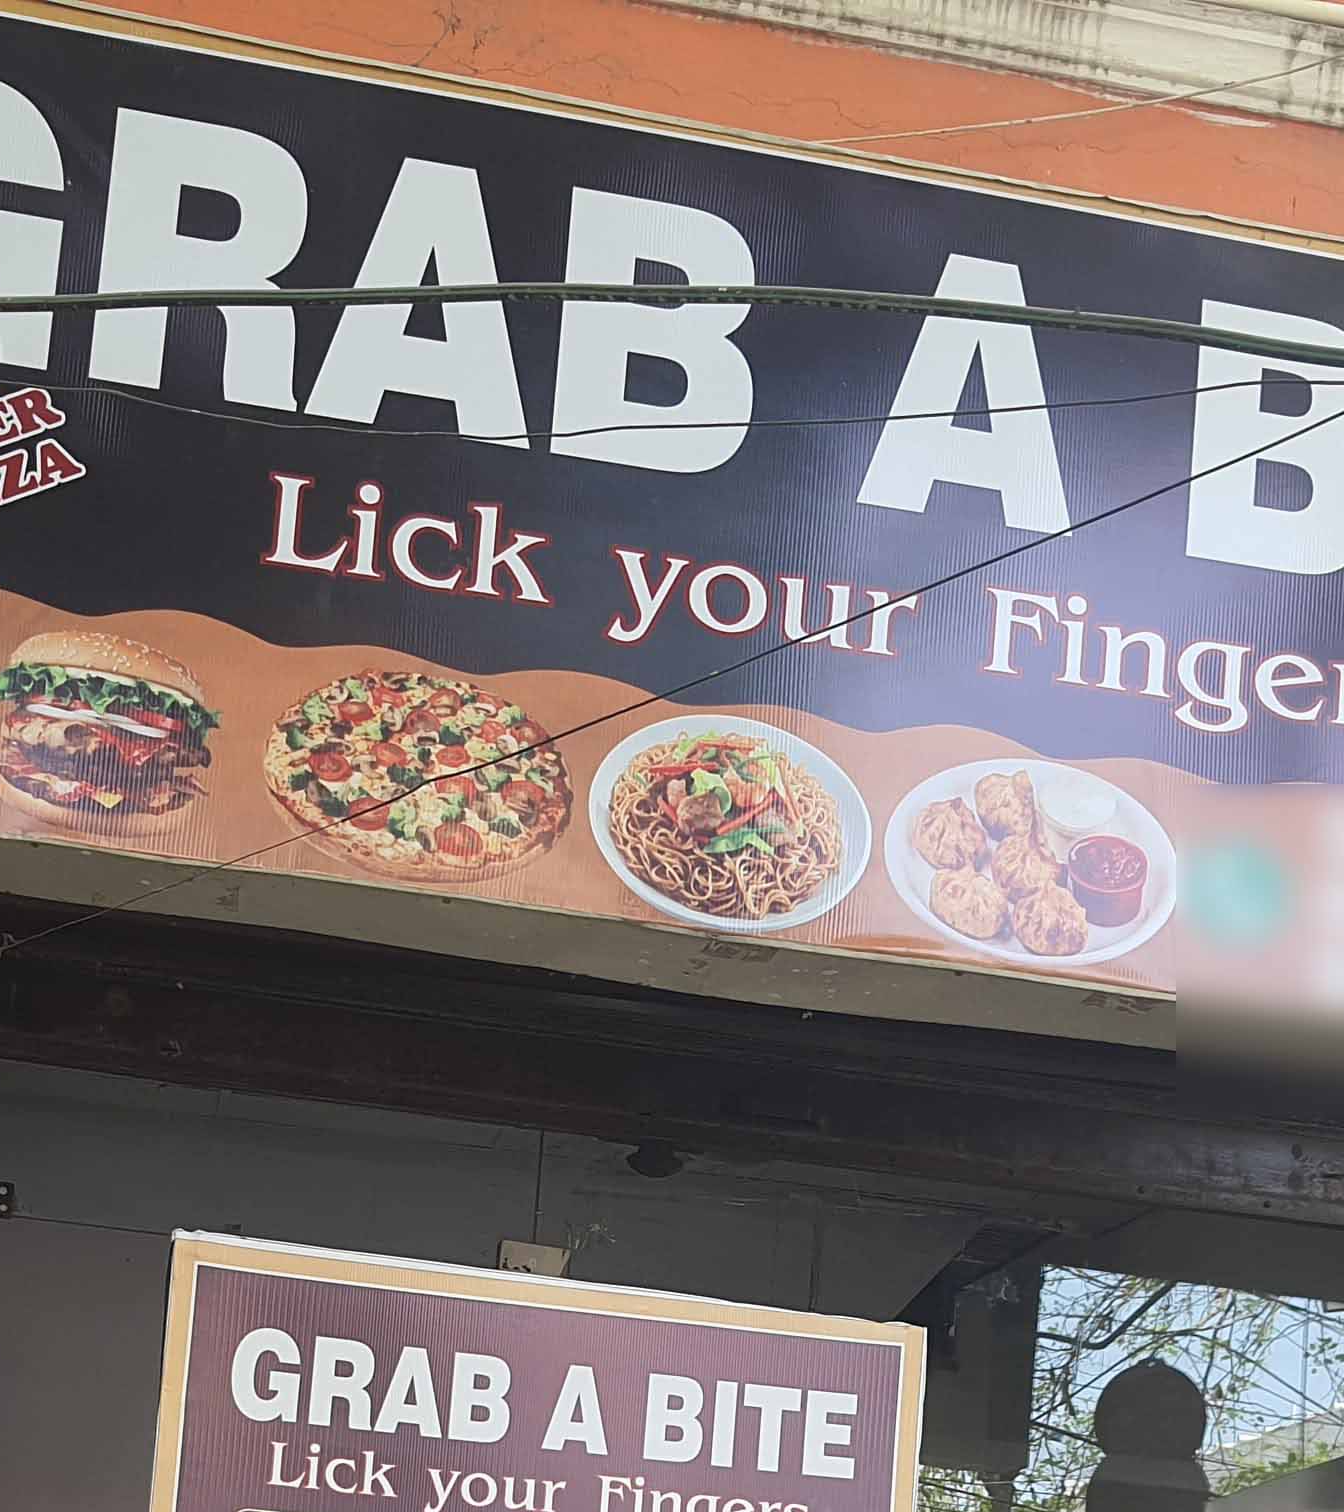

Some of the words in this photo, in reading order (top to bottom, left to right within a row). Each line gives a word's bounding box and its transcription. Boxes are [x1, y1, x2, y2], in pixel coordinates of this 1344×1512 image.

[857, 254, 1072, 537] A
[264, 472, 553, 605] Lick
[608, 543, 919, 691] your
[230, 1326, 512, 1444] GRAB
[541, 1365, 608, 1456] A
[643, 1373, 859, 1481] BITE
[266, 1440, 399, 1499] Lick
